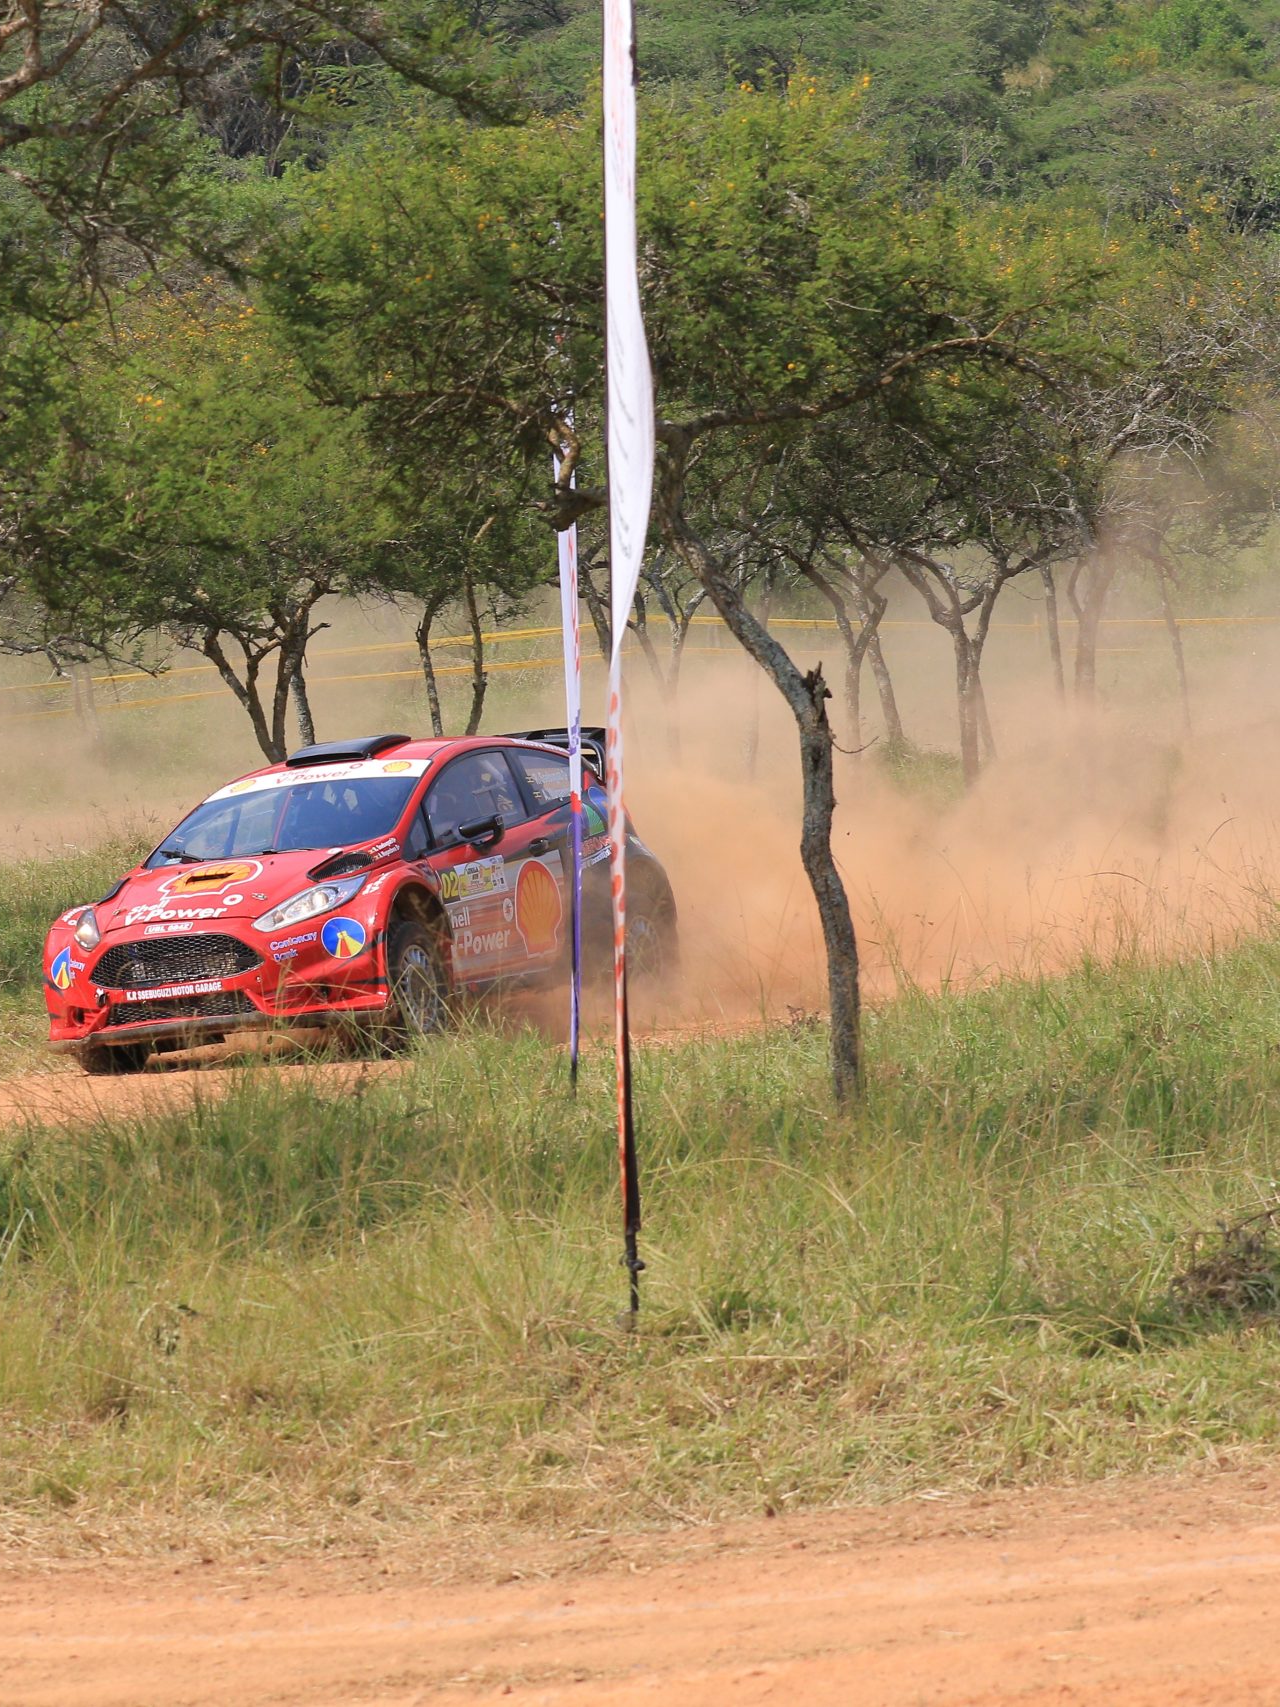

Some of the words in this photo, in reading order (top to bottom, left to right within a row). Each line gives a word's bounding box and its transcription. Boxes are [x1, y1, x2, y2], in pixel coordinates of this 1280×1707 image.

[129, 898, 171, 915] Shell
[124, 907, 228, 927] V-Power
[449, 906, 471, 929] hell
[138, 986, 172, 1000] SSEBUGUZI
[172, 983, 195, 996] MOTOR
[195, 981, 223, 993] GARAGE
